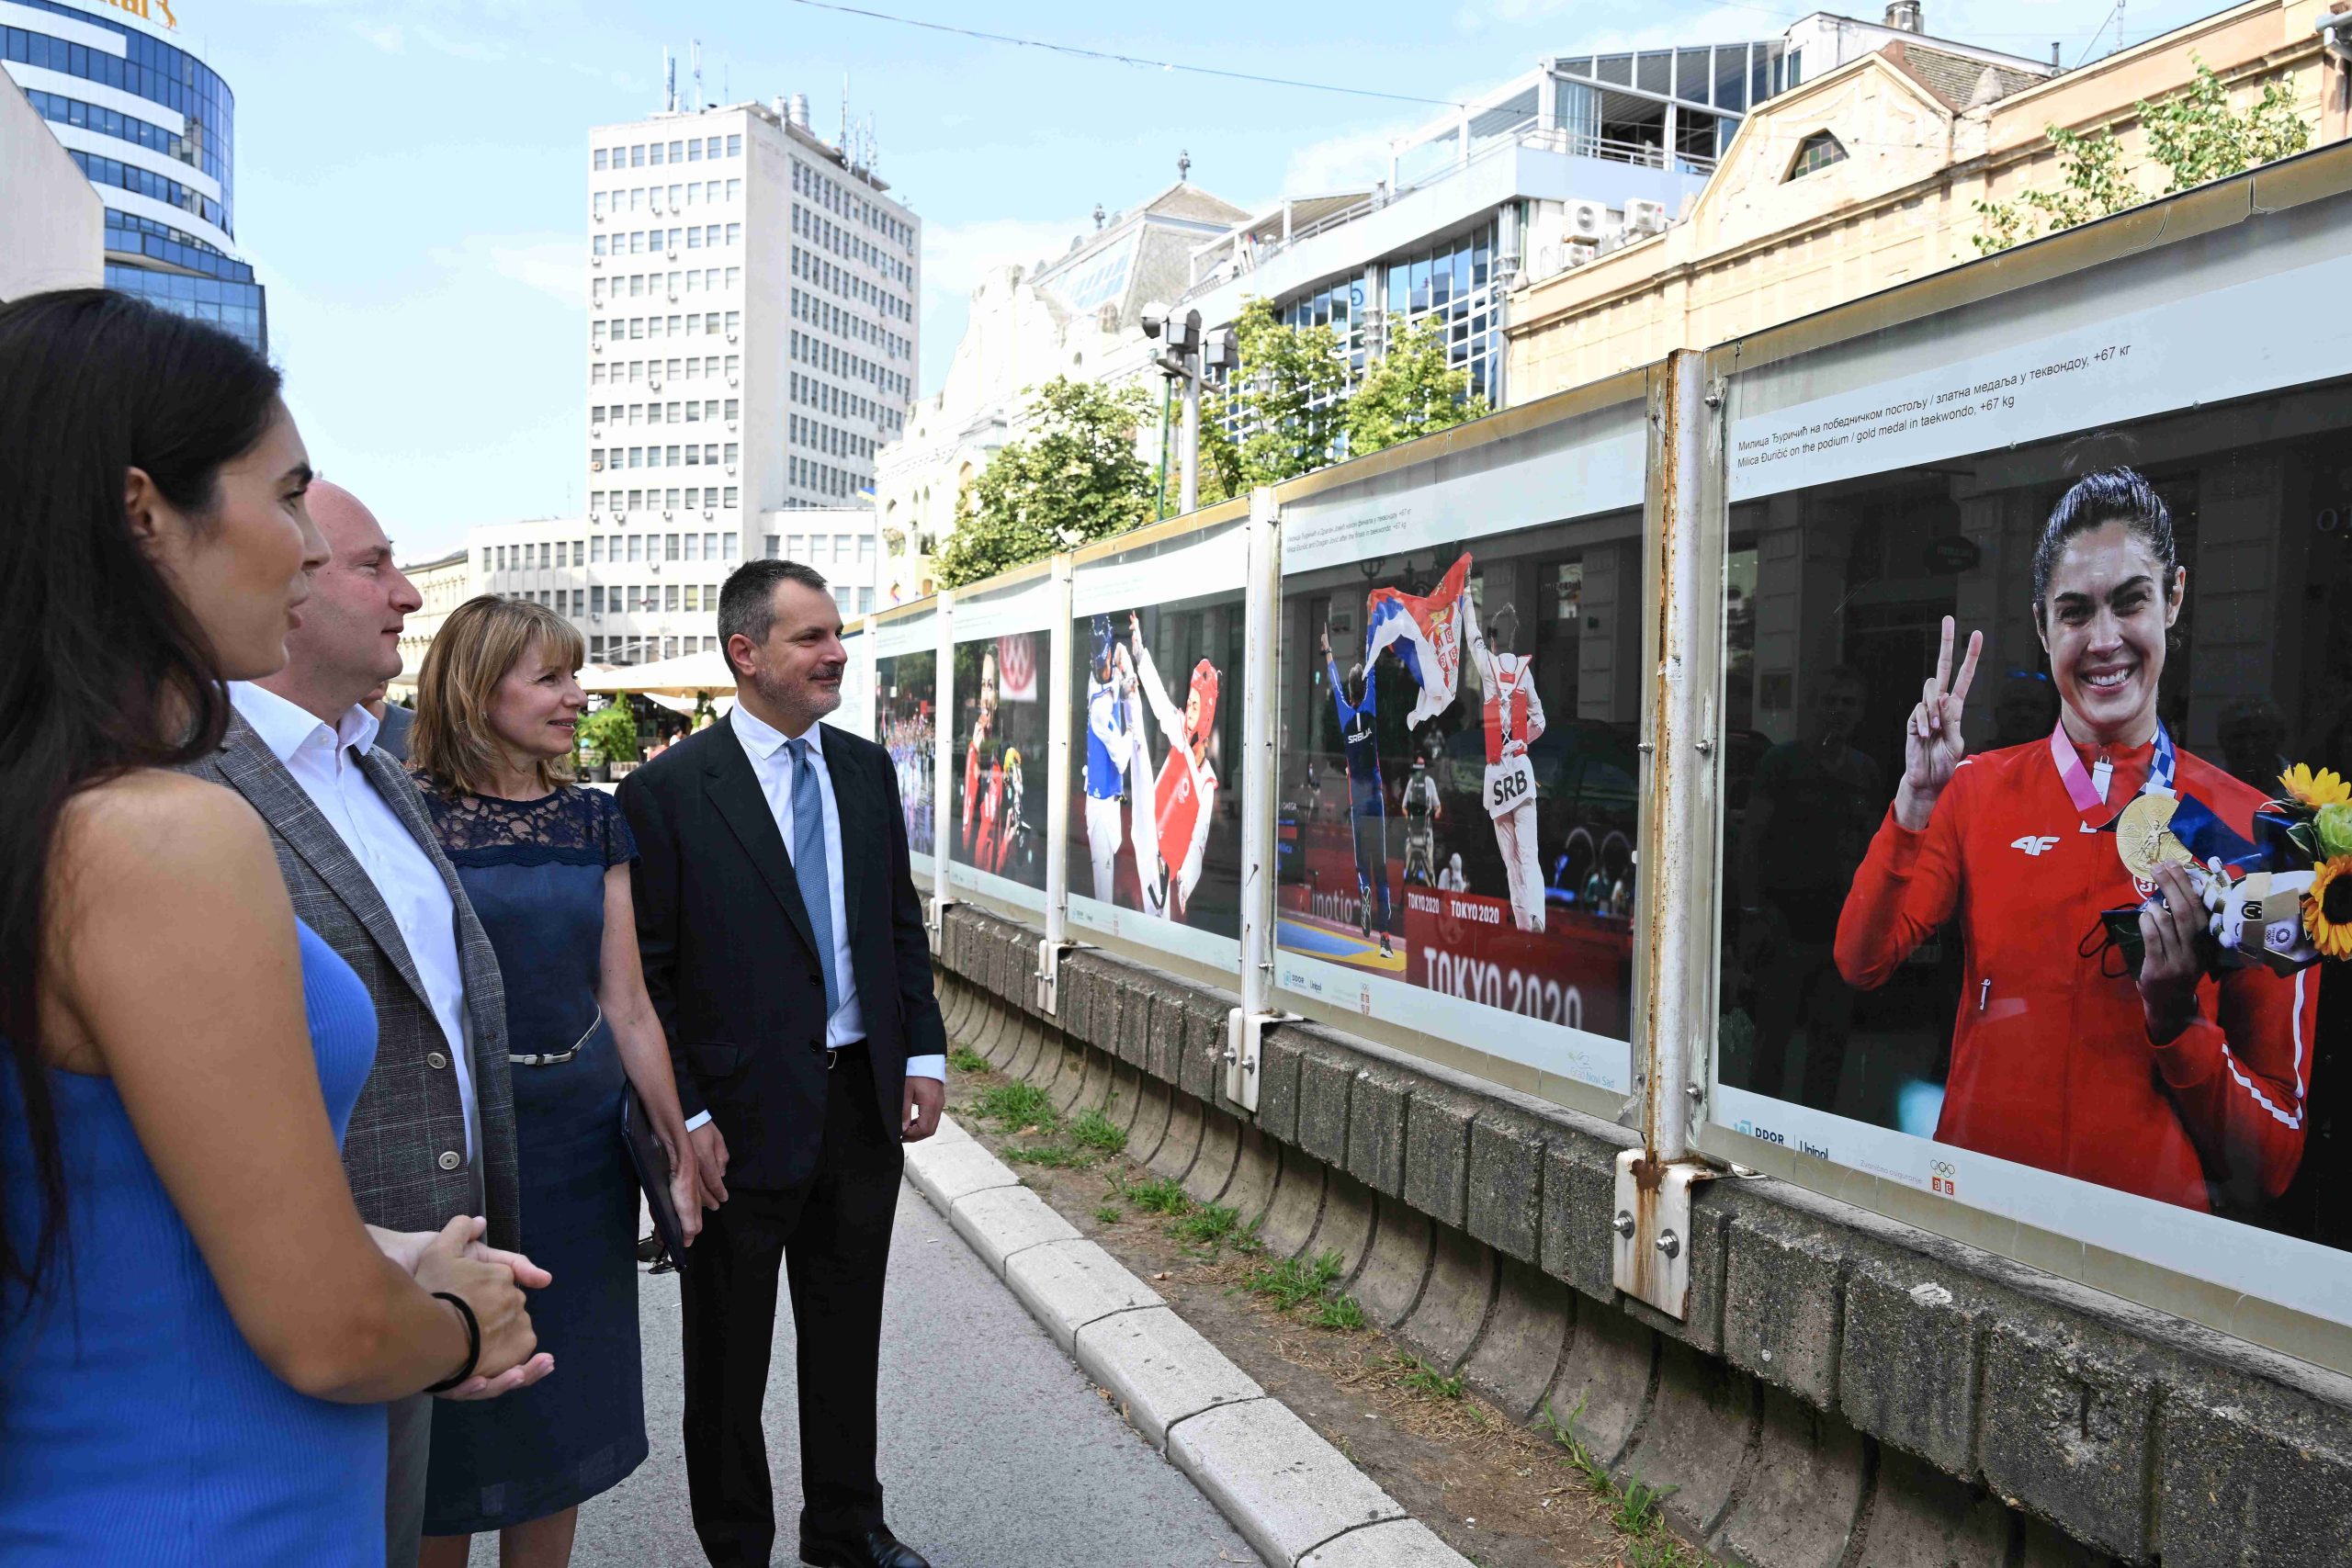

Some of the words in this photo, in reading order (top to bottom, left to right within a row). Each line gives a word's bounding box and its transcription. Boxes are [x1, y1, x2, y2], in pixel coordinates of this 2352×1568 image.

[1738, 437, 1770, 452] Милица
[1771, 426, 1807, 445] Ђуричић
[1810, 423, 1821, 434] на
[1823, 410, 1883, 431] победничком
[1885, 398, 1928, 416] постољу
[1929, 395, 1933, 405] /
[1936, 388, 1971, 404] златна
[1973, 375, 2018, 394] медаља
[2020, 373, 2026, 385] у
[2030, 356, 2089, 379] теквондоу,
[2094, 346, 2116, 361] +67
[2120, 345, 2131, 356] кг
[1737, 456, 1759, 468] Milica
[1761, 449, 1788, 463] Đuričić
[1790, 447, 1800, 457] on
[1802, 440, 1815, 453] the
[1817, 434, 1849, 453] podium
[1857, 427, 1876, 444] gold
[1878, 419, 1907, 436] medal
[1909, 419, 1917, 429] in
[1921, 405, 1976, 427] taekwondo,
[1980, 398, 1999, 411] +67
[2002, 396, 2015, 408] kg
[1348, 728, 1373, 744] SRBIJA
[1493, 770, 1528, 807] SRB
[1408, 892, 1425, 911] TOKYO
[1425, 897, 1440, 915] 2020
[1451, 900, 1477, 921] TOKYO
[1478, 906, 1499, 924] 2020
[1424, 946, 1501, 1010] TOKYO
[1508, 968, 1582, 1031] 2020
[1586, 1071, 1600, 1084] Novi
[1601, 1076, 1614, 1089] Sad
[1756, 1127, 1784, 1145] DDOR
[1800, 1140, 1828, 1159] Unipol
[1860, 1159, 1888, 1175] Zvanično
[1889, 1169, 1923, 1185] osiguranje
